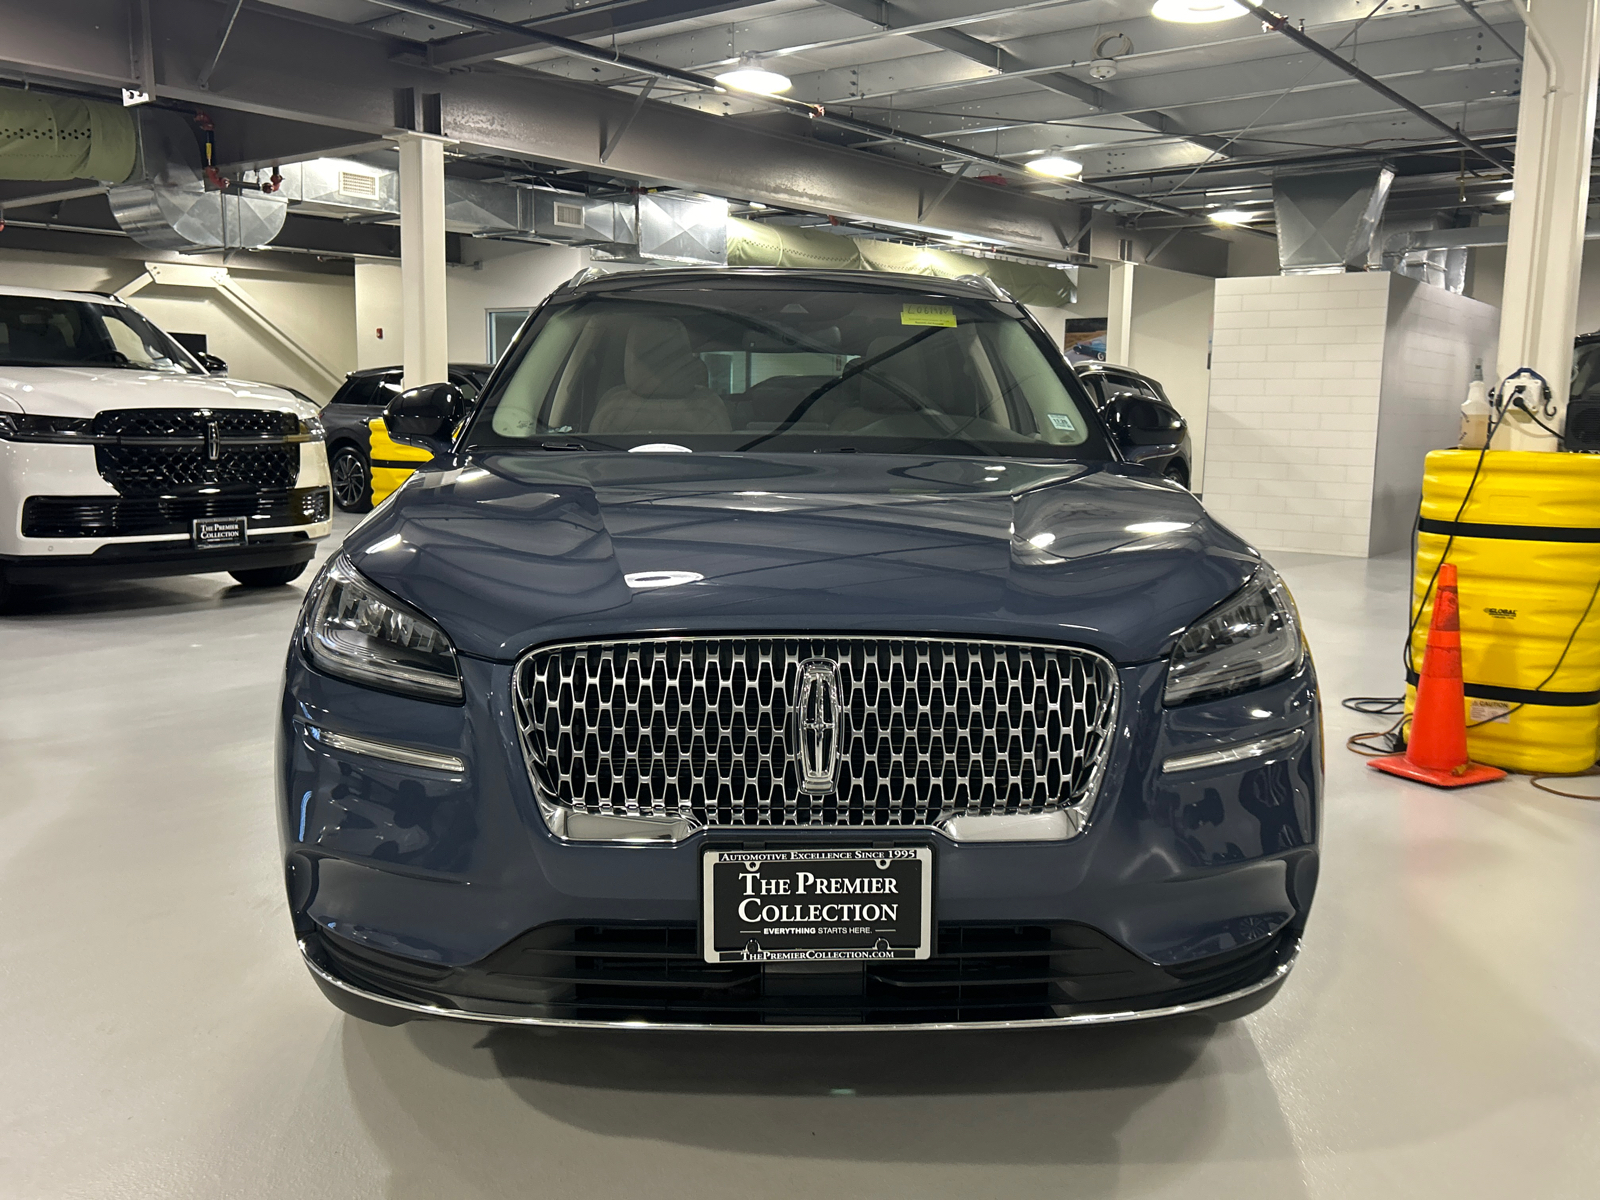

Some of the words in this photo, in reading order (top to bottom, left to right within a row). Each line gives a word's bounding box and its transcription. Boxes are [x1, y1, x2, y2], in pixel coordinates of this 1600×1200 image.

[1479, 700, 1509, 708] CAUTION
[721, 852, 788, 861] AUTOMOTIVE
[790, 851, 853, 860] EXCELLENCE
[855, 850, 885, 859] SINCE
[888, 849, 915, 858] 1995
[738, 872, 791, 896] THE
[795, 871, 899, 895] PREMIER
[738, 898, 899, 922] COLLECTION
[763, 927, 817, 935] EVERYTHING
